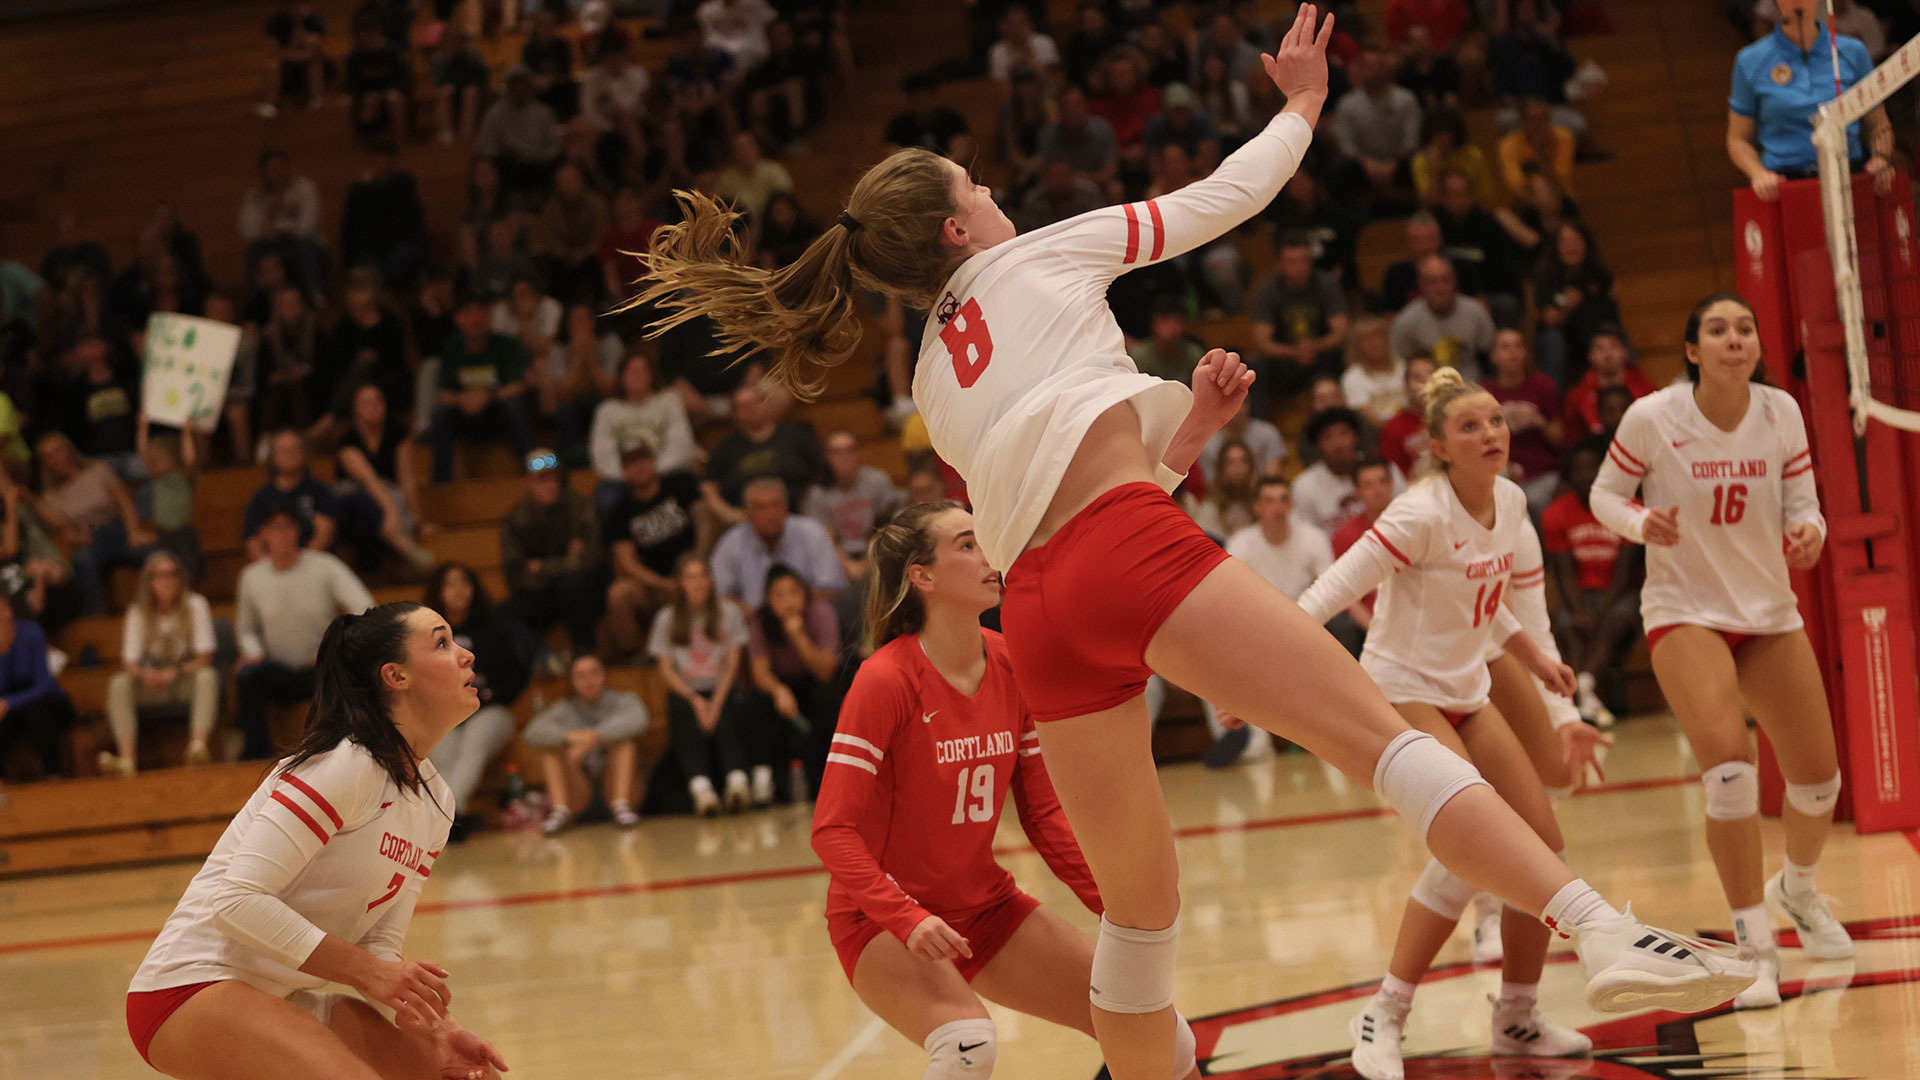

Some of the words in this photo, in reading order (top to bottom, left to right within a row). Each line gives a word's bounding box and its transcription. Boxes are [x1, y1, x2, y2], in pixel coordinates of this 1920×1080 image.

[939, 295, 993, 389] 8
[1691, 459, 1767, 479] CORTLAND
[1709, 483, 1748, 525] 16
[1473, 580, 1503, 628] 14
[936, 730, 1014, 764] CORTLAND
[951, 763, 995, 825] 19
[379, 831, 424, 871] CORTLA
[366, 871, 406, 914] 7
